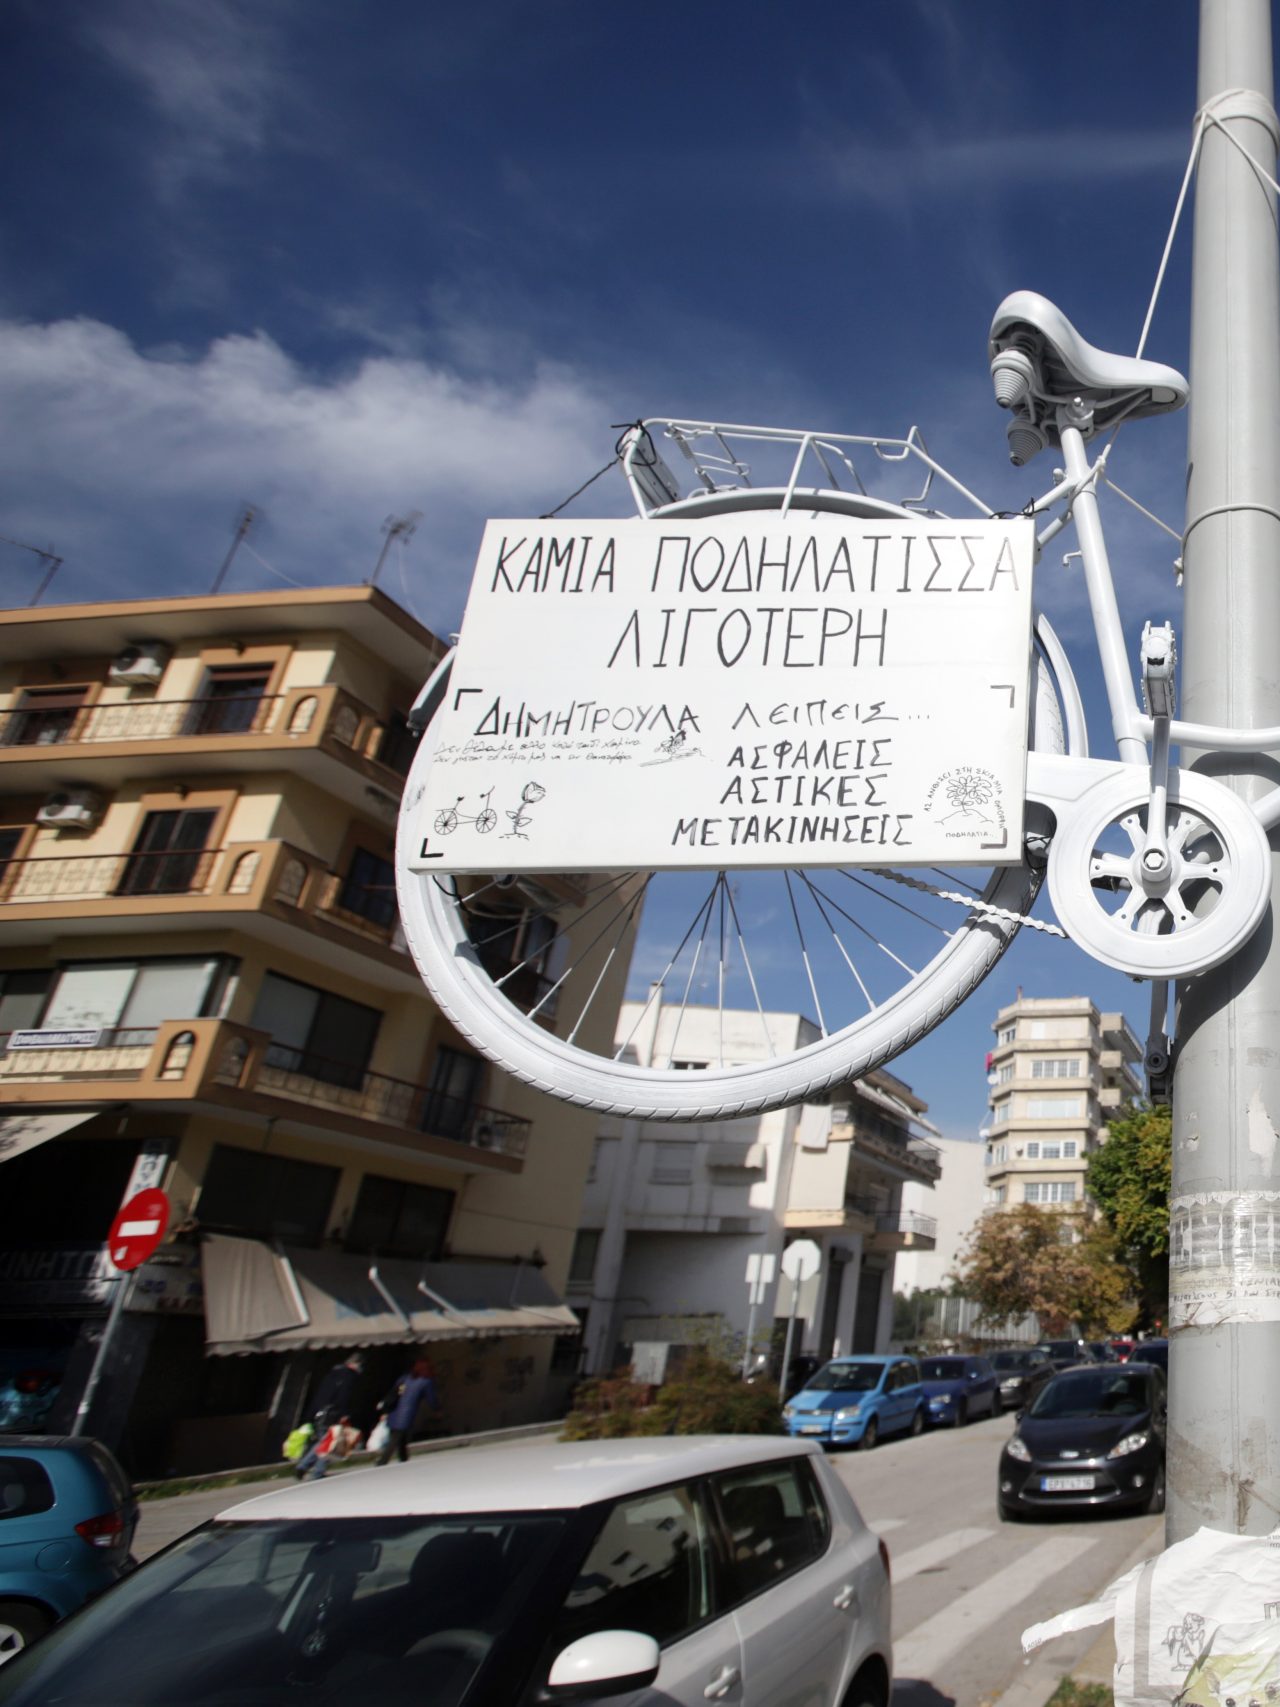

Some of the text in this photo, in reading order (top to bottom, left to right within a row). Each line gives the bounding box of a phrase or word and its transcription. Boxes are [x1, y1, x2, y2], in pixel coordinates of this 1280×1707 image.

[491, 535, 1020, 593] ΚΑΜΙΑ ΠΟΔΗΛΑΤΙΣΣΑ
[607, 608, 888, 668] ΛΙΓΟΤΕΡΗ
[473, 696, 701, 738] ΔΗΜΗΤΡΟΥΛΑ
[727, 738, 892, 770] ΑΣΦΑΛΕΙΣ
[720, 773, 888, 807] ΑΣΤΙΚΕΣ
[671, 813, 914, 846] ΜΕΤΑΚΙΝΗΣΕΙΣ
